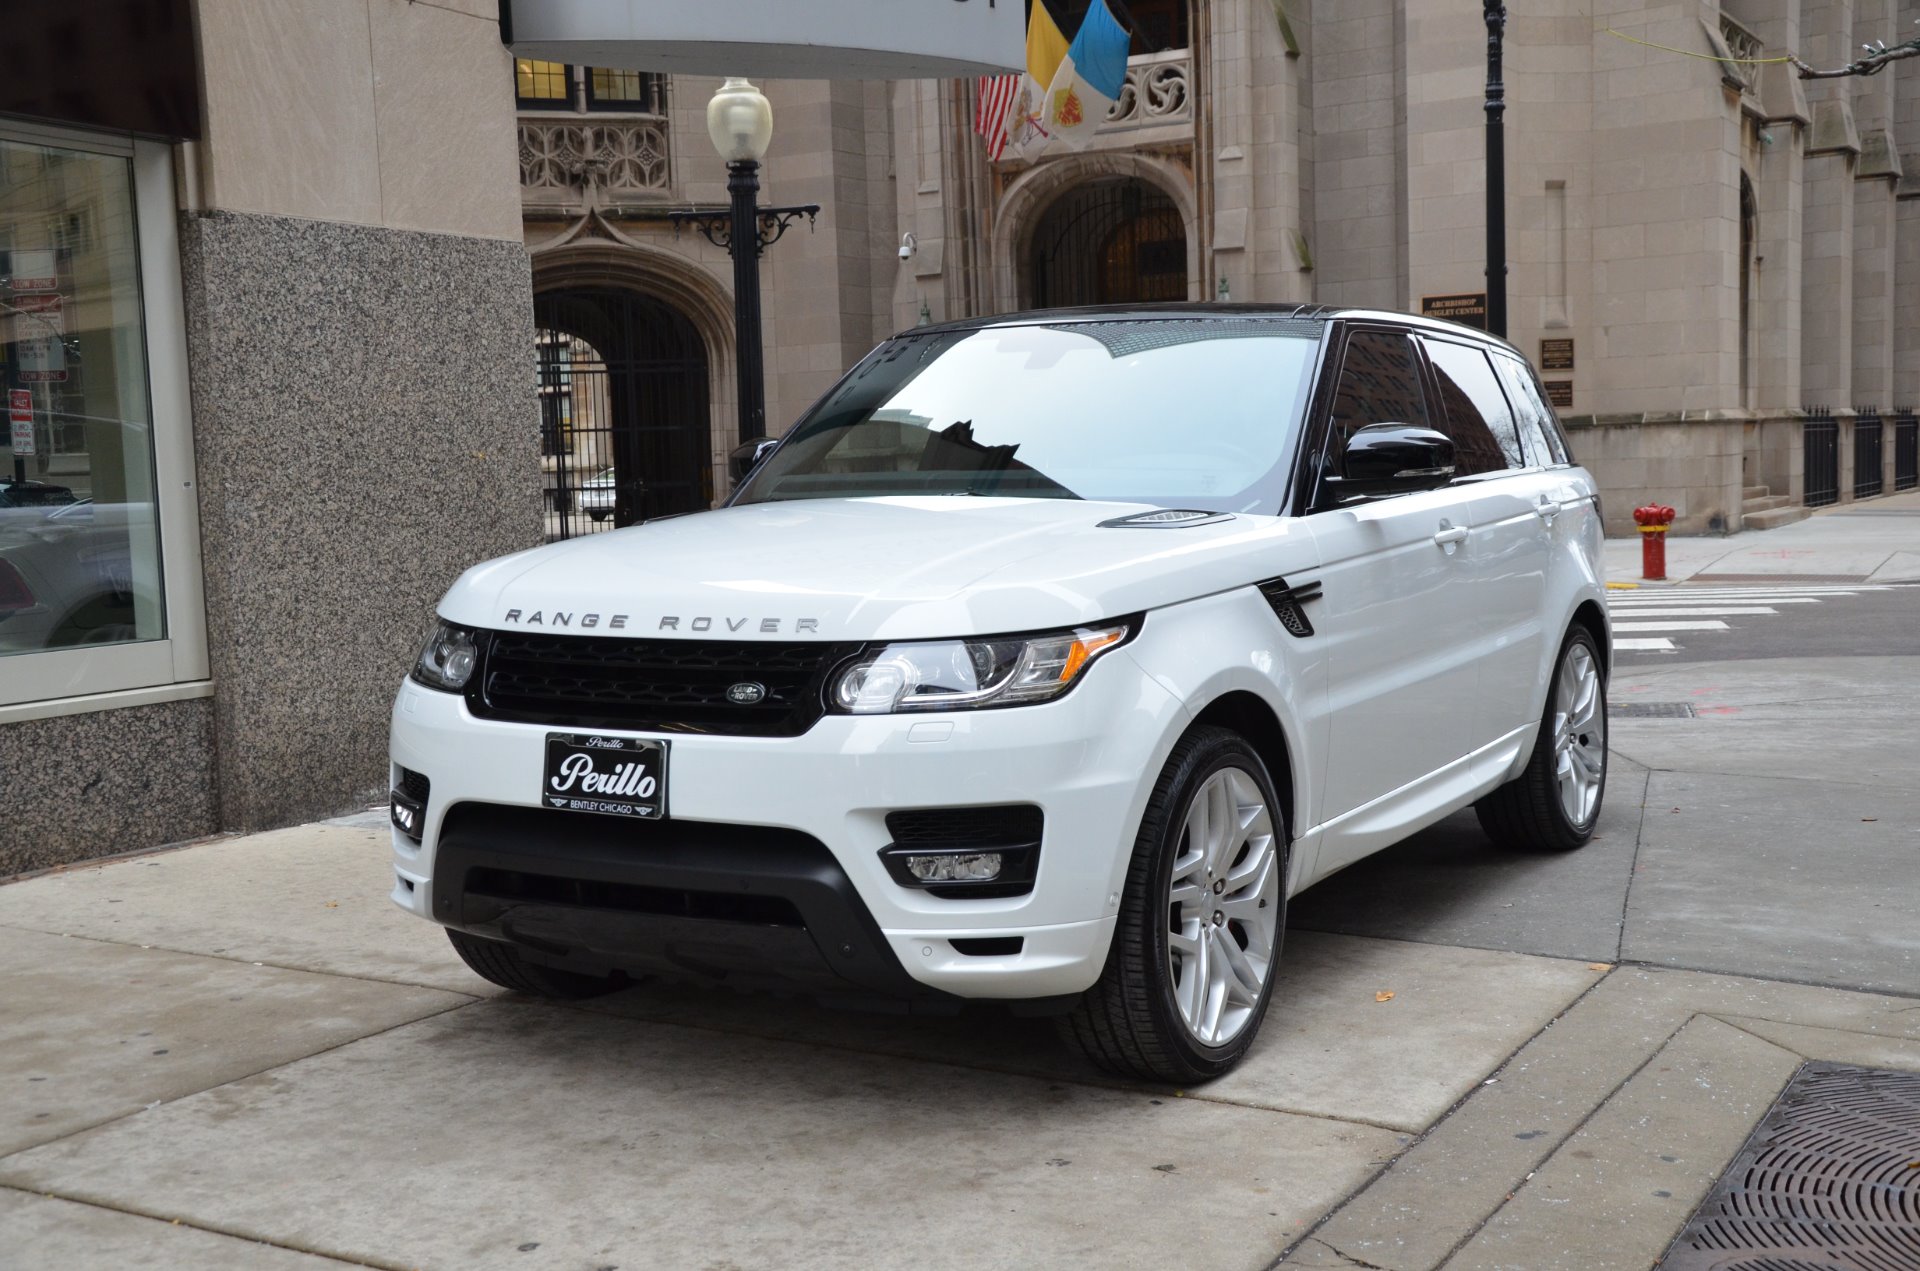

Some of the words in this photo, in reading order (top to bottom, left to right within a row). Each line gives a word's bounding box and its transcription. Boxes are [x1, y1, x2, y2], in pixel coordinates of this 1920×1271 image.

[15, 279, 30, 289] TOW
[33, 279, 53, 288] ZONE
[1431, 298, 1477, 308] ARCHBISHOP
[1424, 308, 1455, 317] QUIGLEY
[1455, 307, 1484, 315] CENTER
[20, 372, 37, 381] TOW
[38, 371, 62, 380] ZONE
[505, 608, 629, 629] RANGE
[659, 615, 820, 633] ROVER
[586, 736, 624, 748] Perillo
[550, 753, 656, 798] Perillo
[570, 800, 598, 811] BENTLEY
[599, 803, 632, 814] CHICAGO
